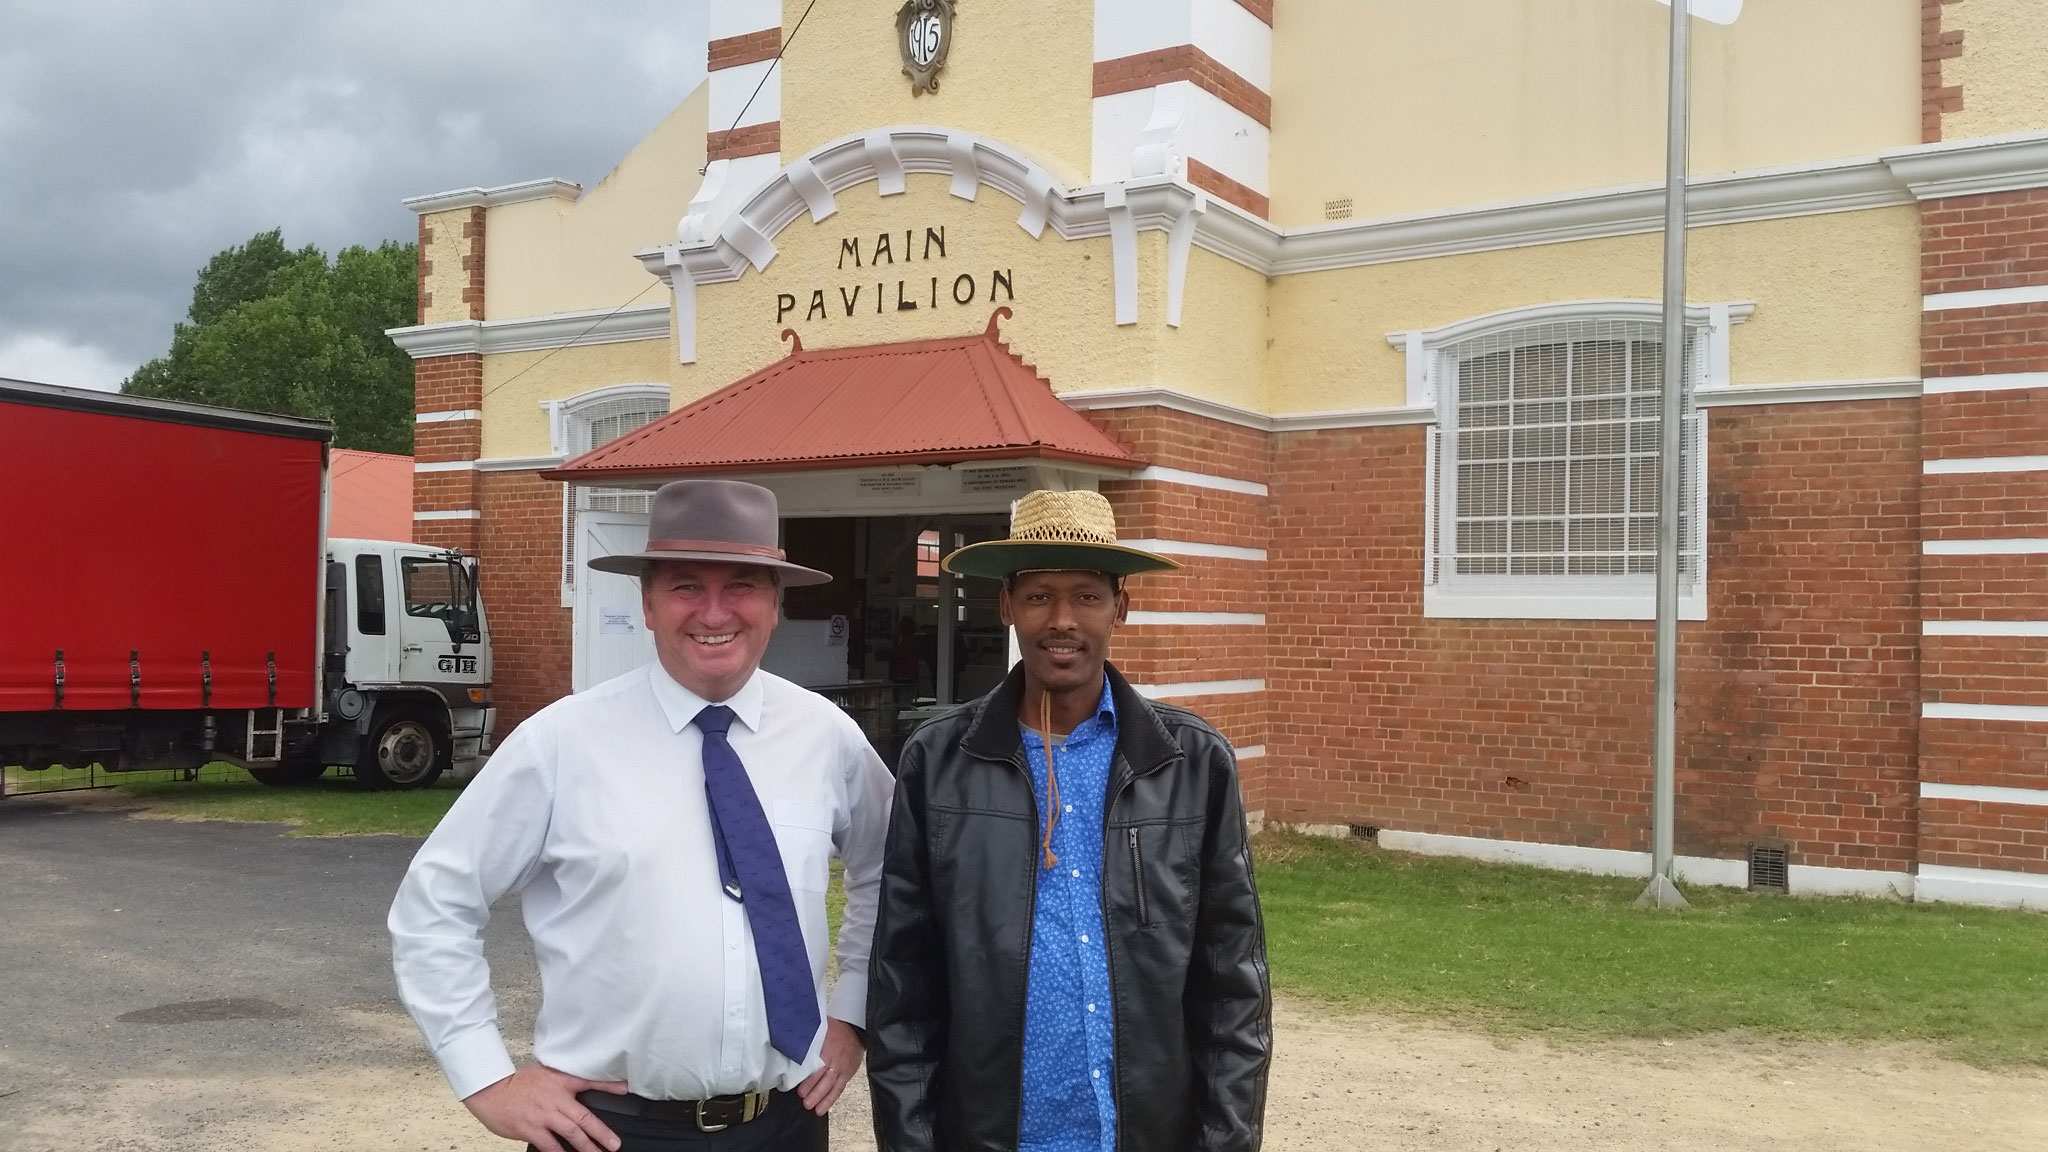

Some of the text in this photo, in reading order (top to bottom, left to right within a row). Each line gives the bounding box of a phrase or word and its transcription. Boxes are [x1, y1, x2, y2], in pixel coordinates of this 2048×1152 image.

[911, 17, 940, 62] 1915
[838, 225, 946, 269] MAIN
[777, 268, 1014, 323] PAVILION
[438, 654, 477, 674] GTH
